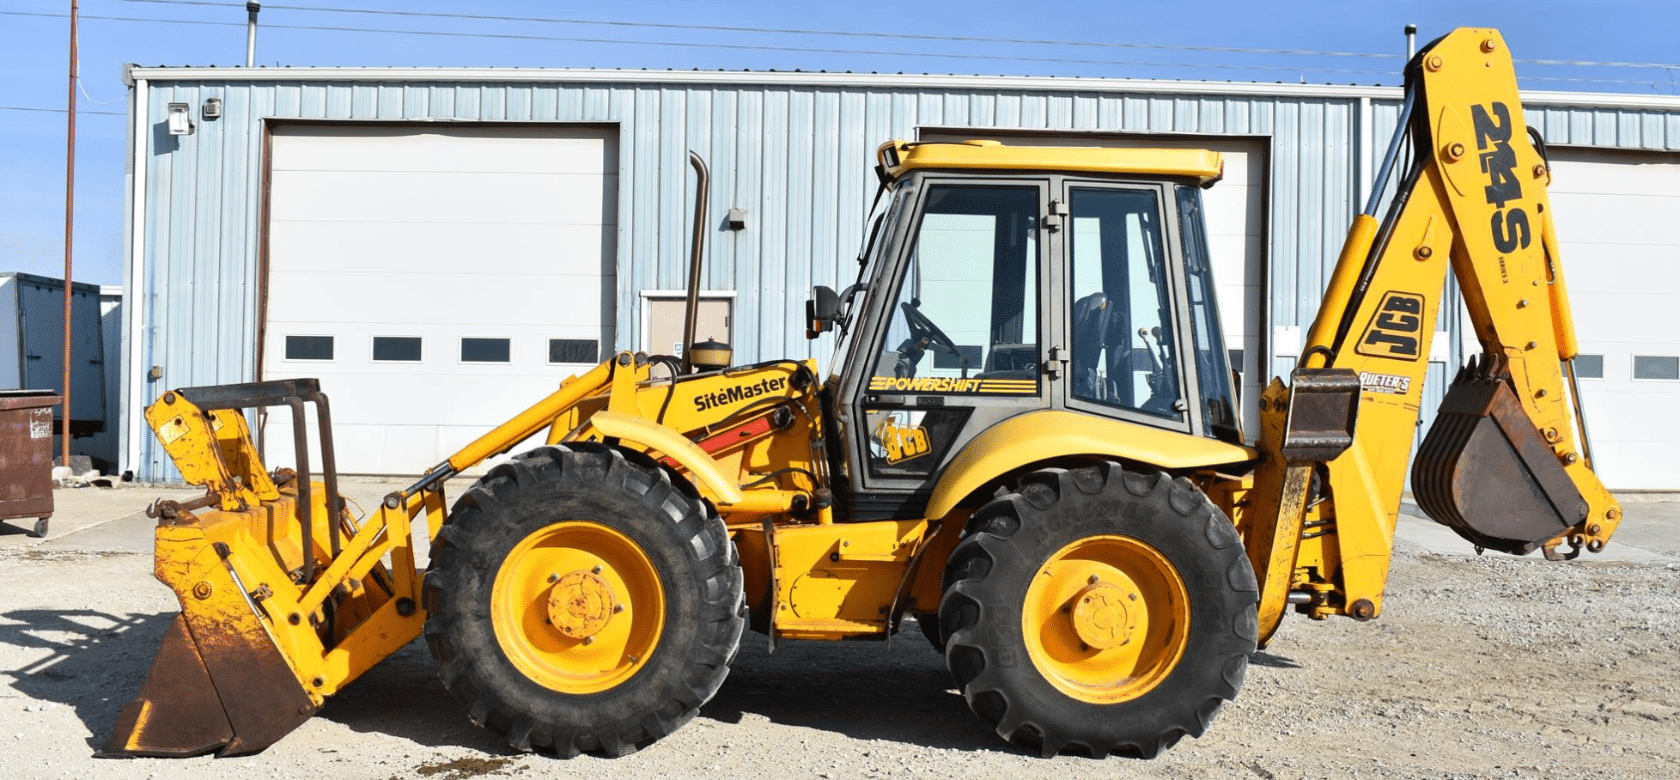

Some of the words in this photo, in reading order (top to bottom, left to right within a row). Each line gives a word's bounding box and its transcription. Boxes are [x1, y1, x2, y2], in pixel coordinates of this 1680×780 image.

[1471, 101, 1531, 254] 214S
[1364, 296, 1420, 356] JCB
[693, 376, 786, 412] SiteMaster
[884, 376, 982, 393] POWERSHIFT
[1359, 371, 1411, 390] RUETER'S
[885, 425, 928, 461] JCB
